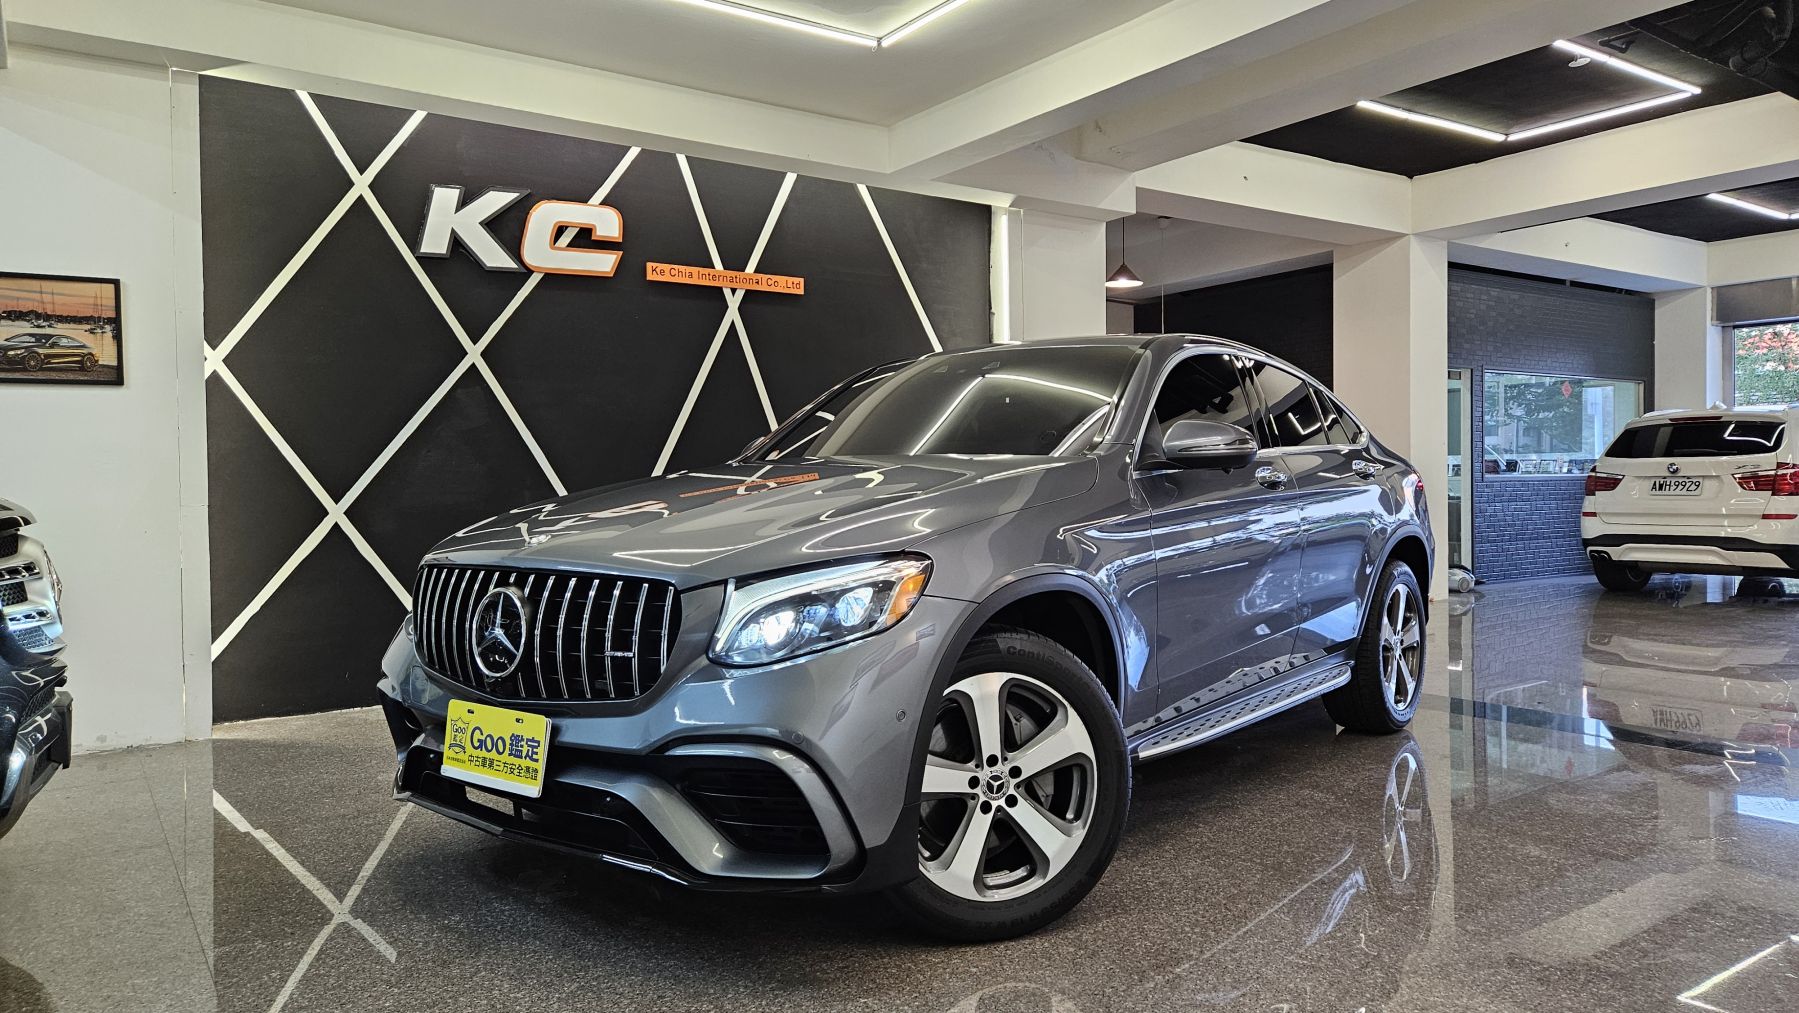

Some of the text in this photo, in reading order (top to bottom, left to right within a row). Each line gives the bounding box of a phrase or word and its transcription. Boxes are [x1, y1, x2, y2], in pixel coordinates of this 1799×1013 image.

[416, 184, 623, 277] KC
[651, 265, 666, 277] Ke
[669, 267, 694, 279] Chia
[697, 270, 763, 286] International
[452, 723, 466, 735] Goo
[470, 726, 541, 763] Goo 鑑定
